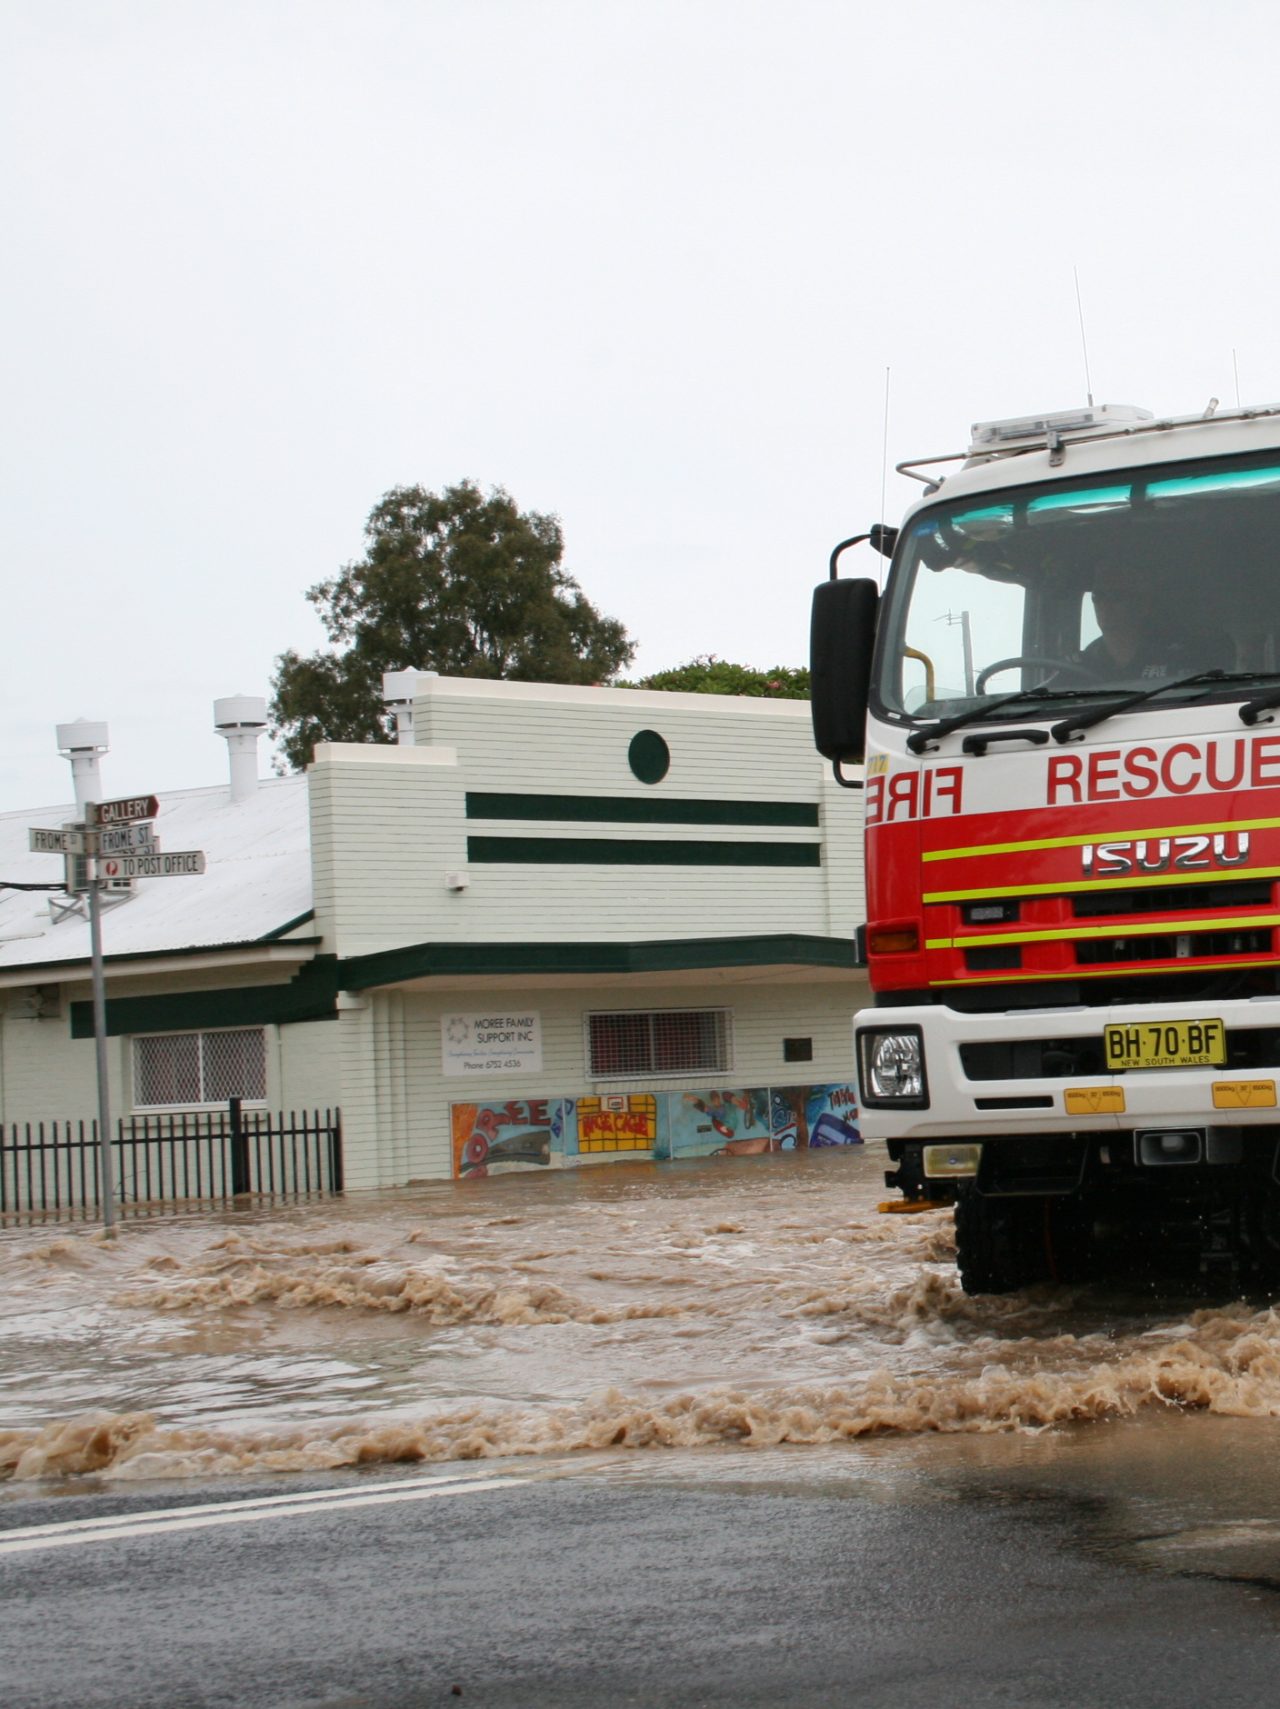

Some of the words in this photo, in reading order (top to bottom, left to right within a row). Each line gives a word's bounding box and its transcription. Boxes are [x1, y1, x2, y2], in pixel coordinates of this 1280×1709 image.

[101, 799, 149, 823] GALLERY
[35, 831, 67, 850] FROME
[103, 828, 133, 851] FROME
[138, 826, 150, 845] ST
[1081, 832, 1249, 878] ISUZU
[122, 859, 133, 876] TO
[137, 856, 161, 875] POST
[165, 854, 199, 874] OFFICE
[474, 1018, 504, 1029] MOREE
[506, 1017, 534, 1028] FAMILY
[476, 1031, 515, 1044] SUPPORT
[517, 1030, 534, 1042] INC
[463, 1061, 484, 1070] Phone
[1145, 1057, 1175, 1066] SOUTH
[1180, 1056, 1210, 1064] WALES
